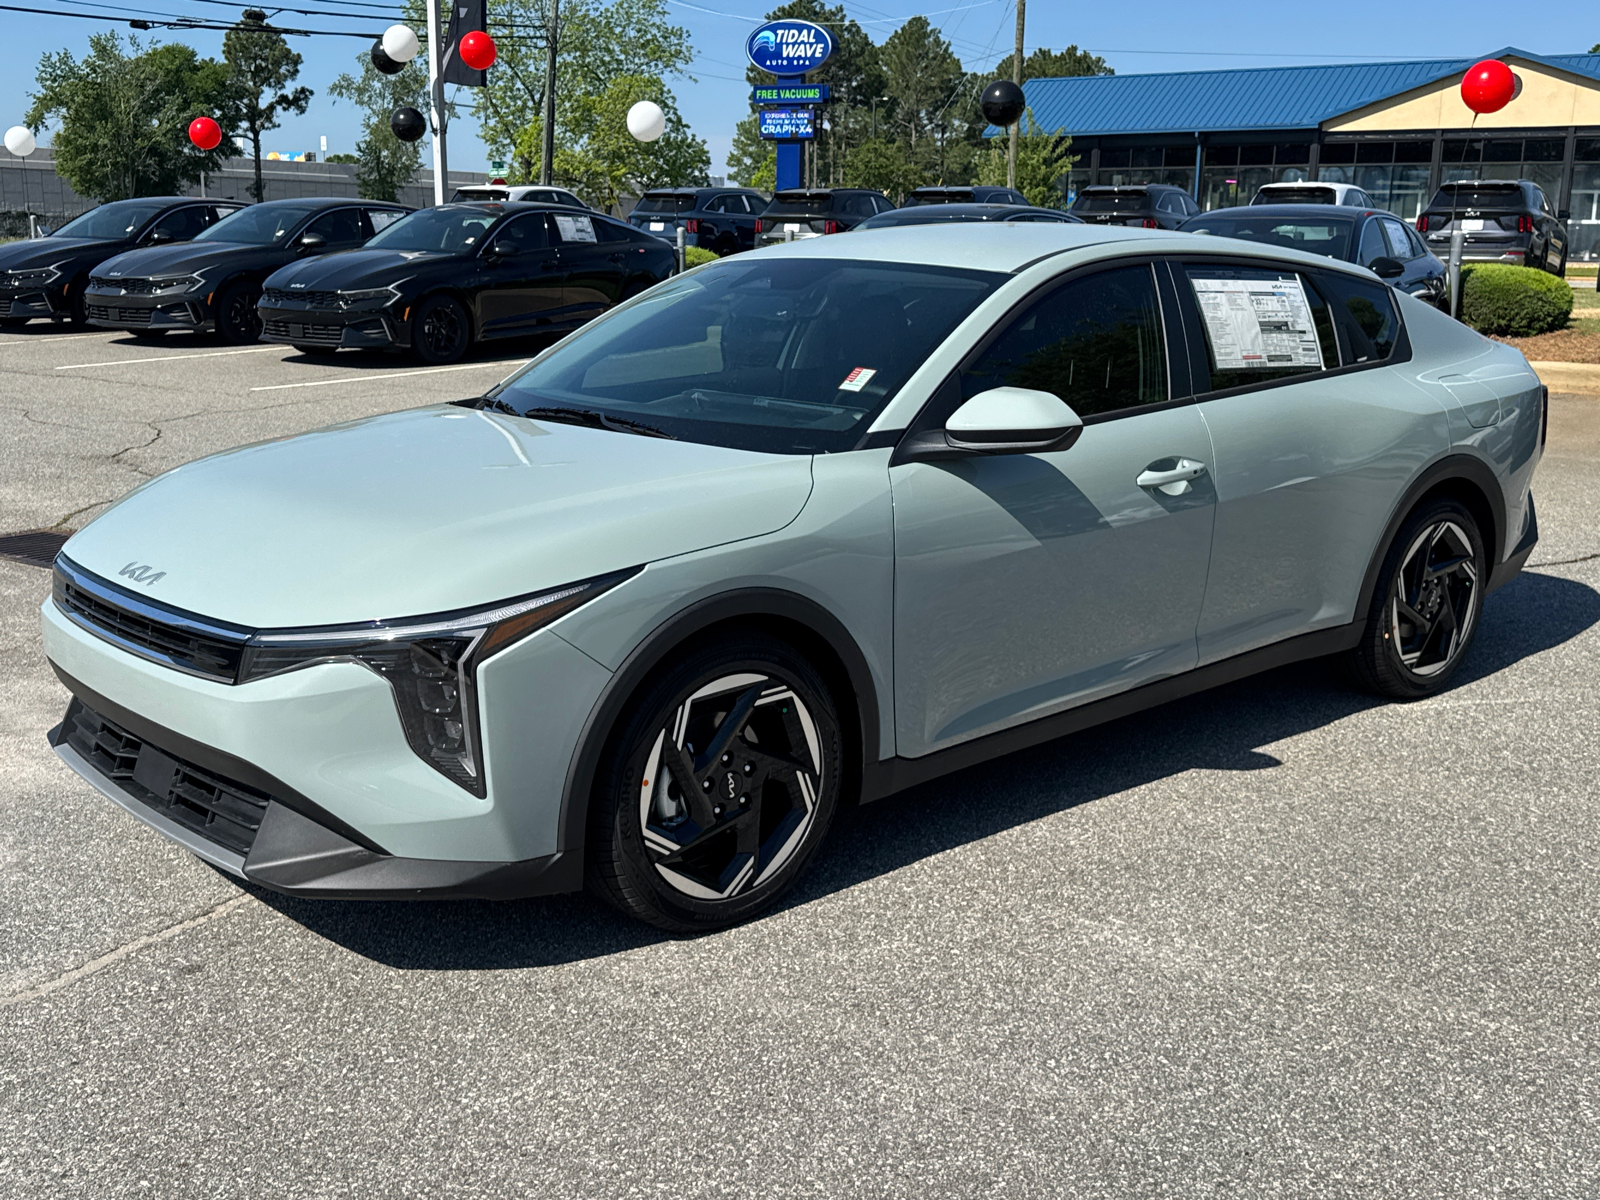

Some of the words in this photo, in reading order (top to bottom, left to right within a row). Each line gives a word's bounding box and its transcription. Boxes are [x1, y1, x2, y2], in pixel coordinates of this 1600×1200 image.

[776, 29, 815, 43] TIDAL
[782, 43, 824, 57] WAVE
[756, 89, 778, 99] FREE
[779, 88, 820, 99] VACUUMS
[761, 124, 813, 134] GRAPH-X4
[118, 561, 167, 586] KIA
